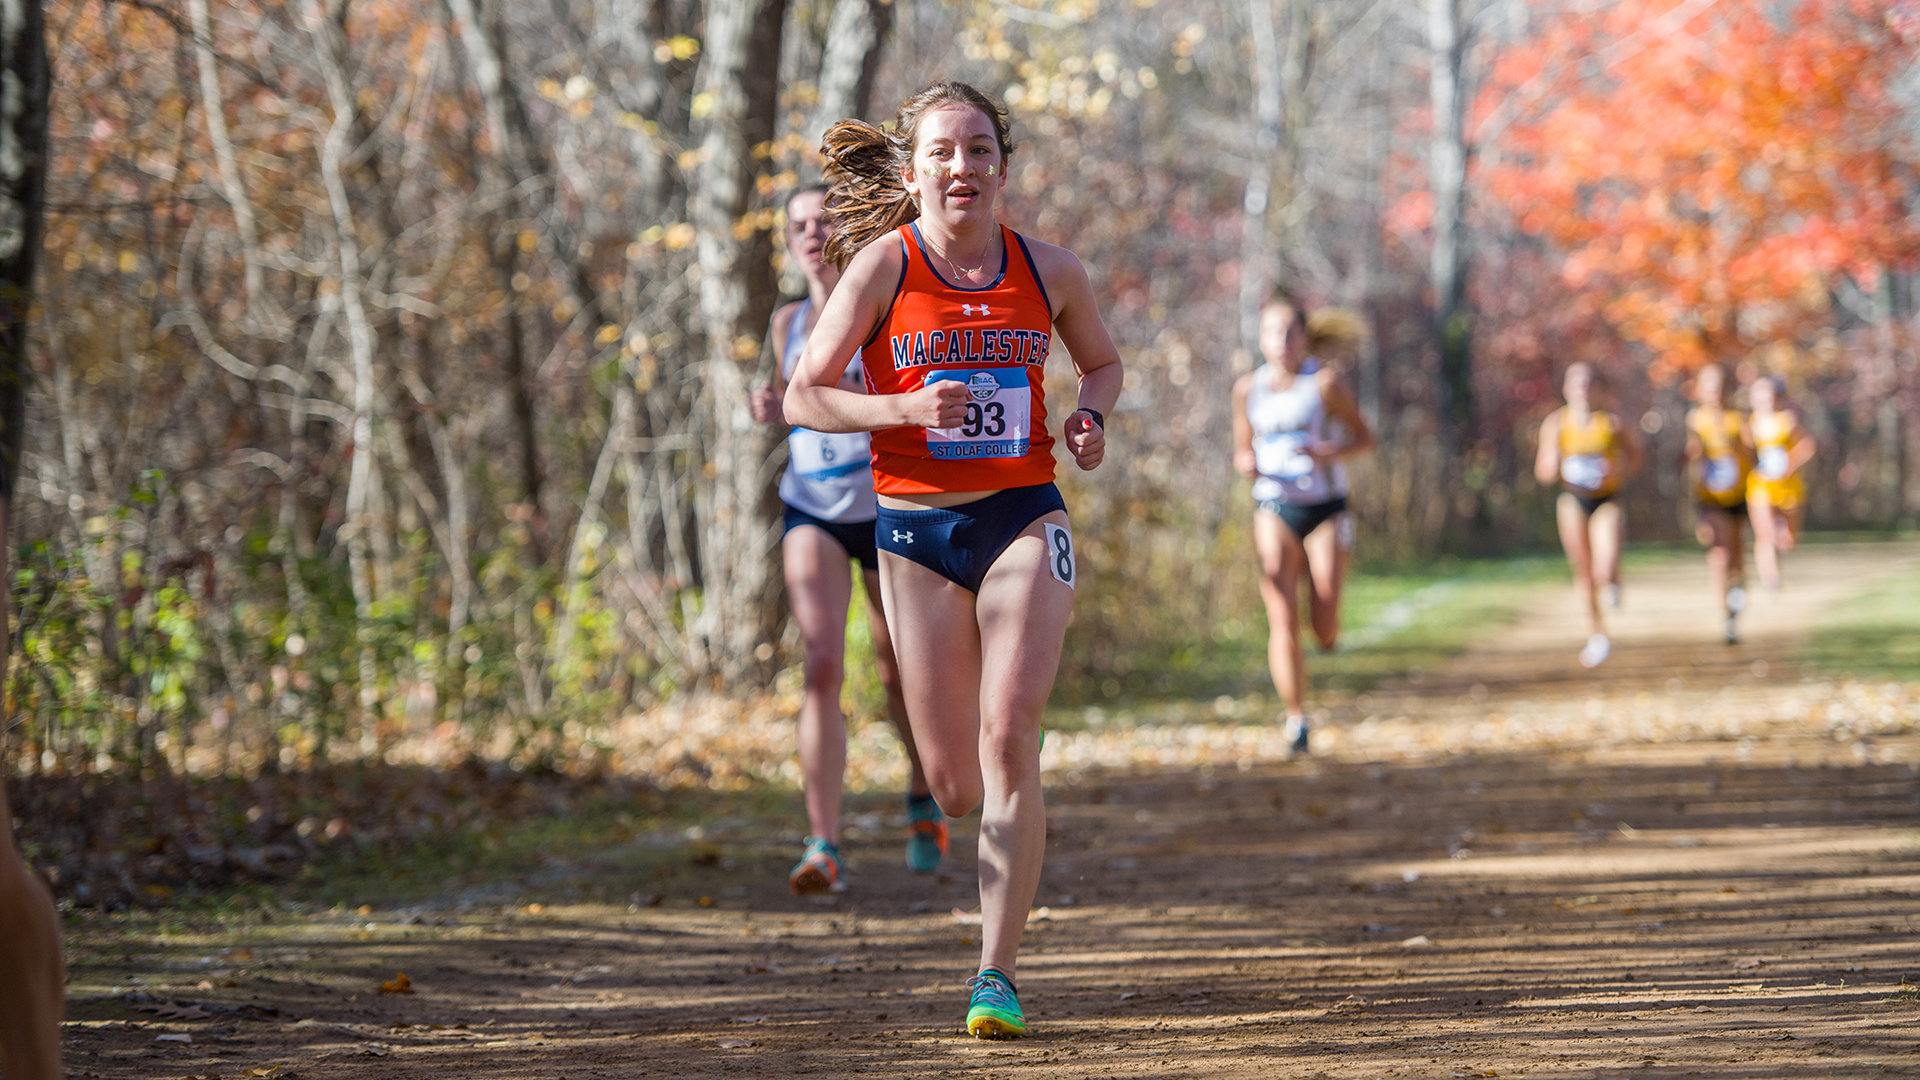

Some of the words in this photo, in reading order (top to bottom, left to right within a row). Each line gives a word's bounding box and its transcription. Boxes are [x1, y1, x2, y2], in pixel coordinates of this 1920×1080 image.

[891, 329, 1049, 371] MACALESTER
[962, 402, 1006, 437] 93
[937, 446, 952, 456] ST.
[955, 445, 982, 456] OLAF
[985, 443, 1026, 455] COLLEGE
[1053, 528, 1072, 582] 8
